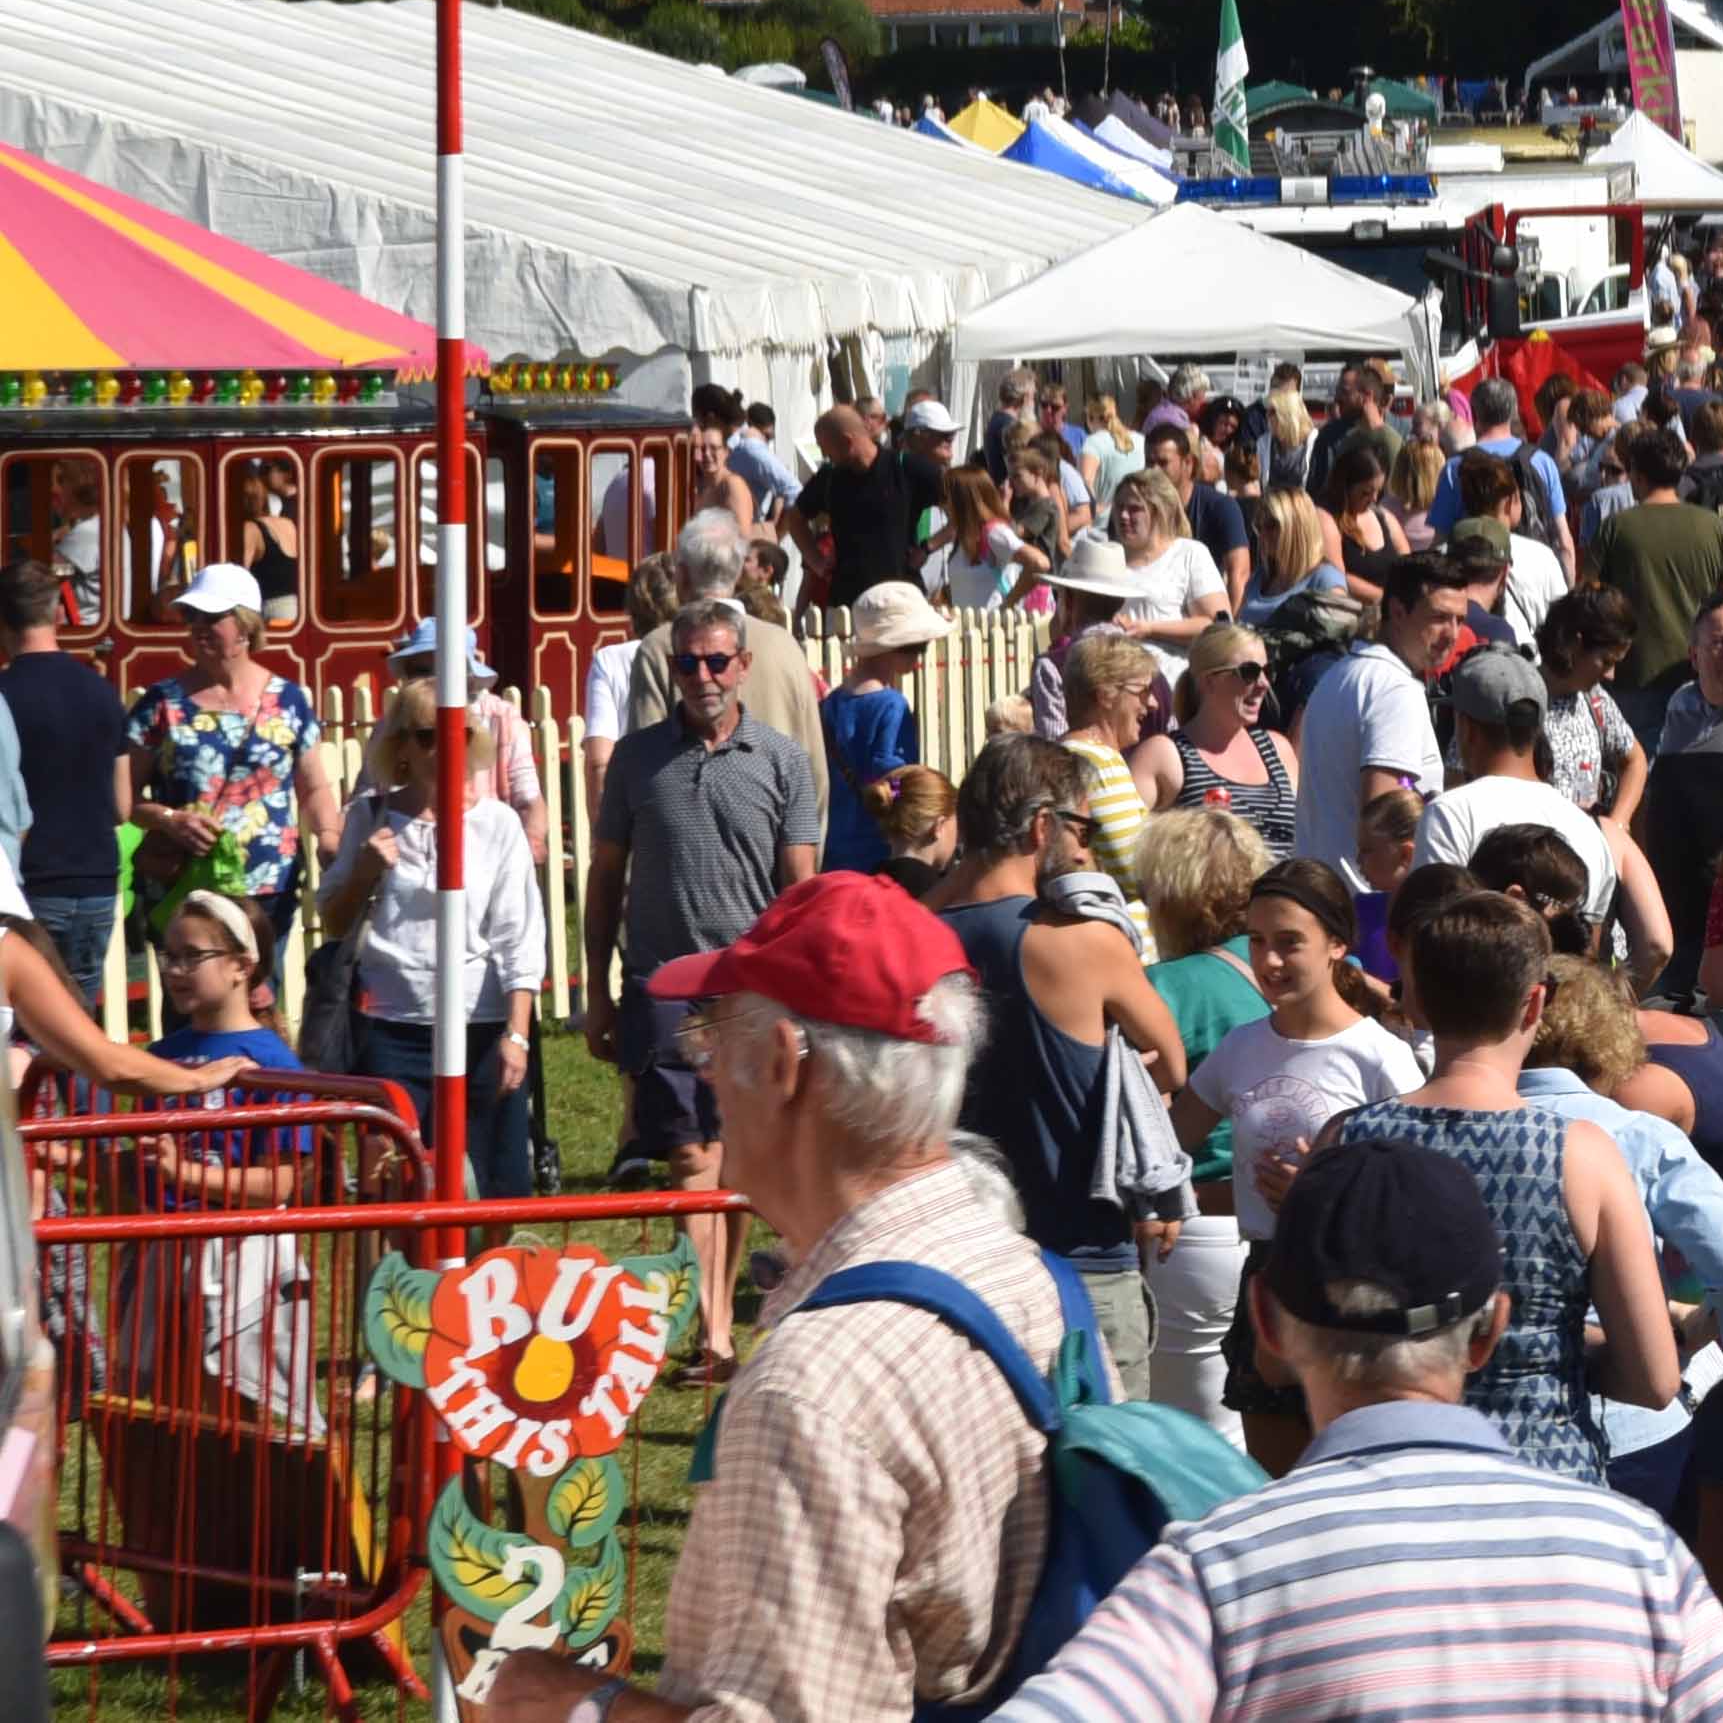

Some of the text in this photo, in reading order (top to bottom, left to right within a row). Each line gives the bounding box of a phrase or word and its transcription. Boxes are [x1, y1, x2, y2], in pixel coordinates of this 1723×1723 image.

[427, 1271, 670, 1477] THIS TALL
[488, 1543, 566, 1651] 2
